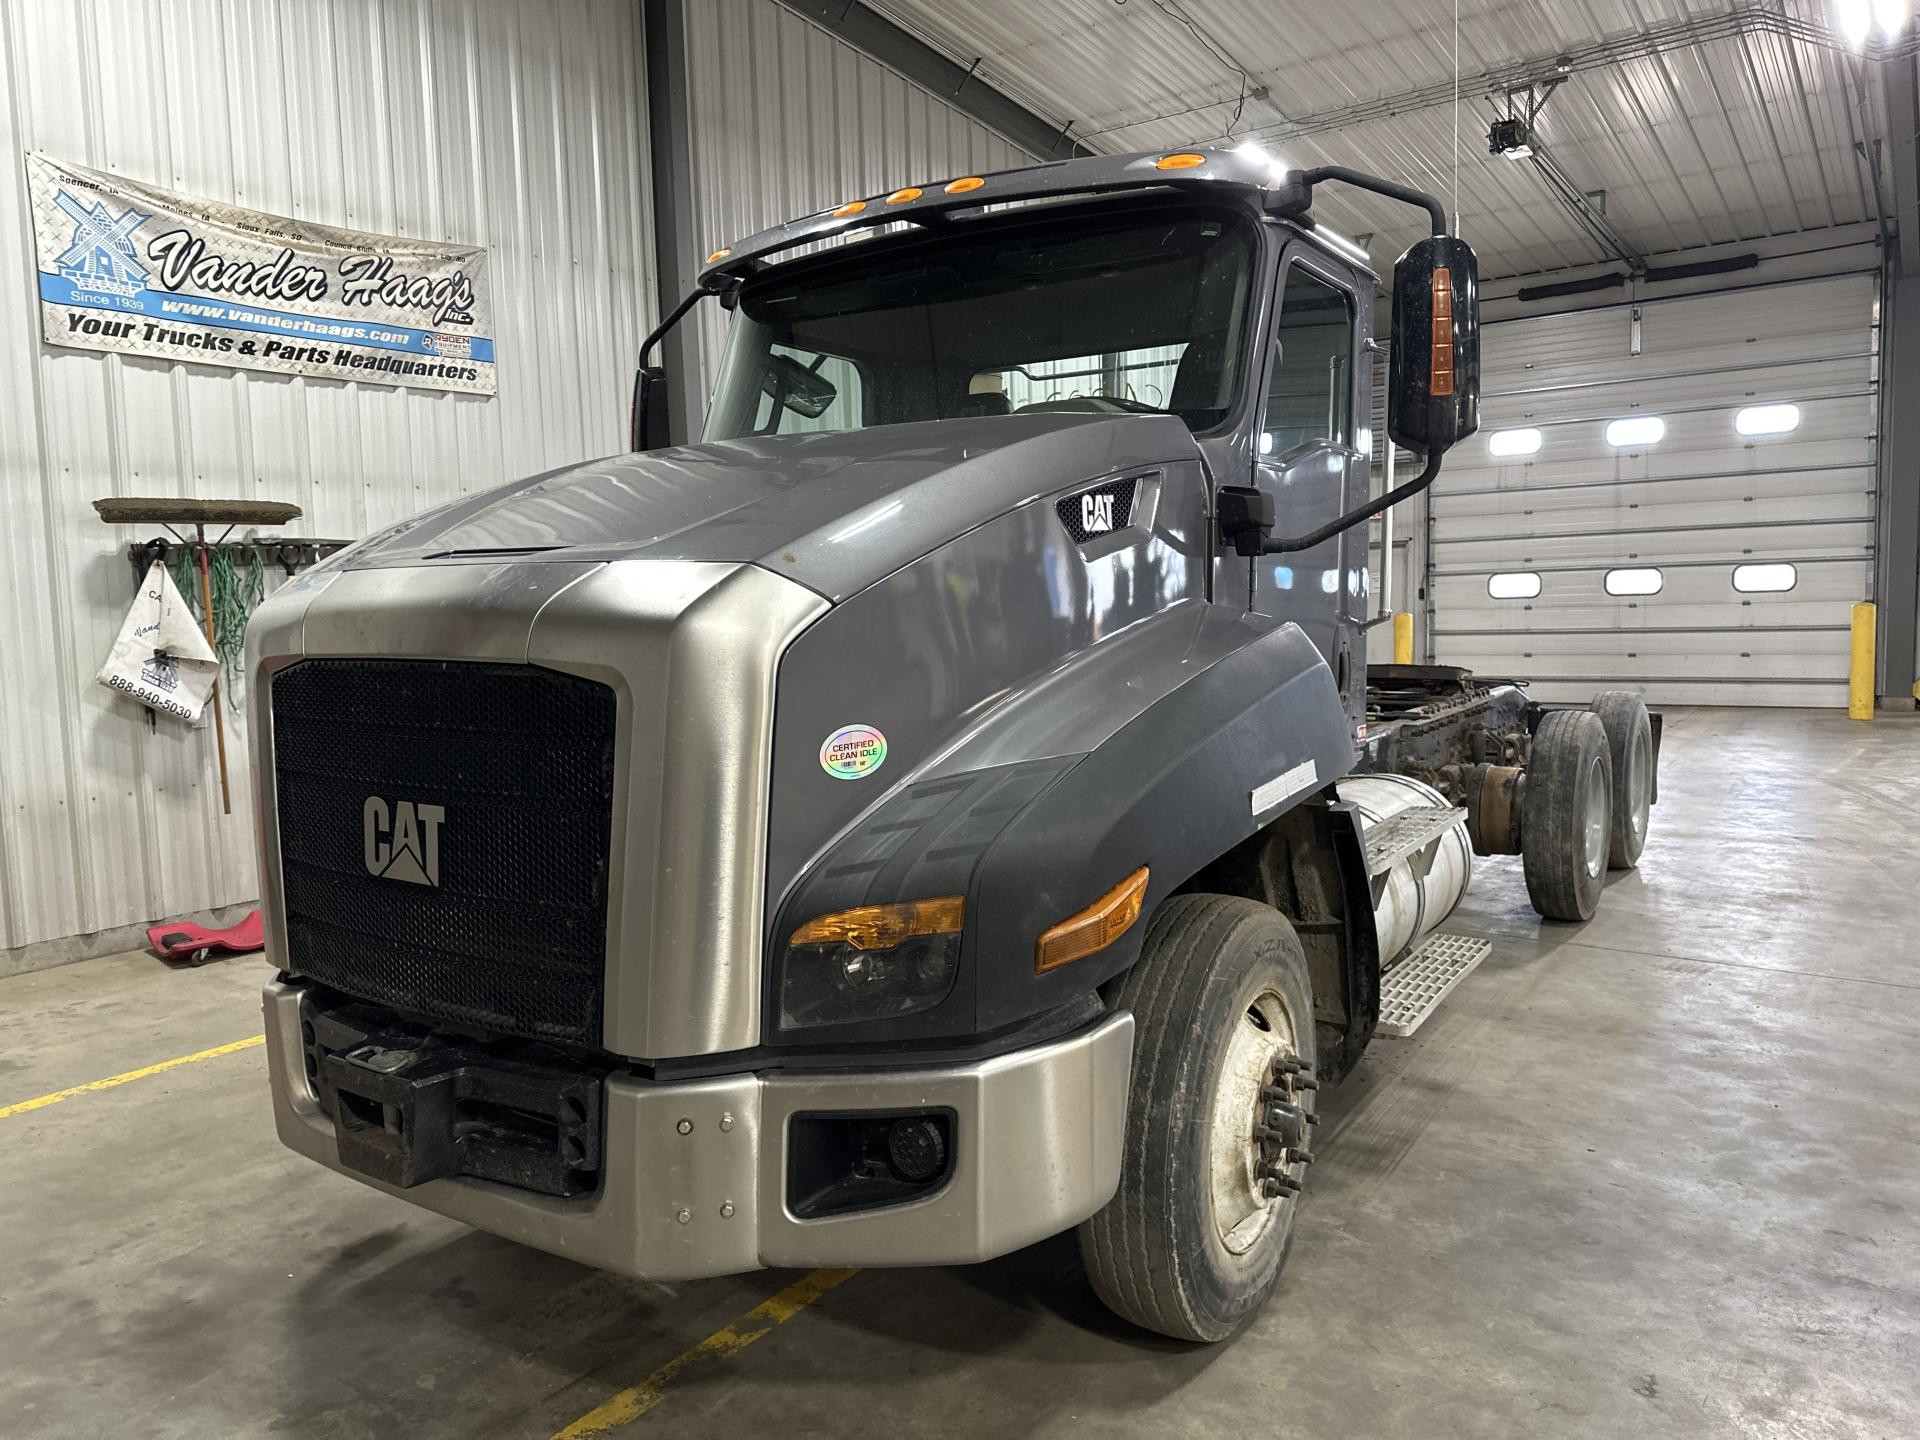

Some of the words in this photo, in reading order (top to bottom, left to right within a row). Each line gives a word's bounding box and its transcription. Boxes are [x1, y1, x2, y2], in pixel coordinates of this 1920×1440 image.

[236, 222, 259, 233] Sioux
[290, 233, 303, 241] SD
[325, 240, 353, 250] Council
[147, 229, 328, 301] Vander
[338, 254, 475, 327] Haag's
[70, 291, 110, 305] Since
[114, 298, 145, 311] 1939
[444, 309, 473, 325] Inc.
[162, 299, 409, 345] www.vanderhaags.com
[67, 313, 136, 338] Your
[142, 323, 234, 352] Trucks
[238, 340, 257, 356] &
[262, 341, 330, 364] Parts
[333, 350, 477, 381] Headquarters
[1081, 494, 1114, 532] CAT
[109, 675, 192, 719] 888-940-5030
[829, 751, 858, 762] CLEAN
[859, 748, 877, 757] IDLE
[832, 739, 874, 752] CERTIFIED
[363, 795, 445, 887] CAT
